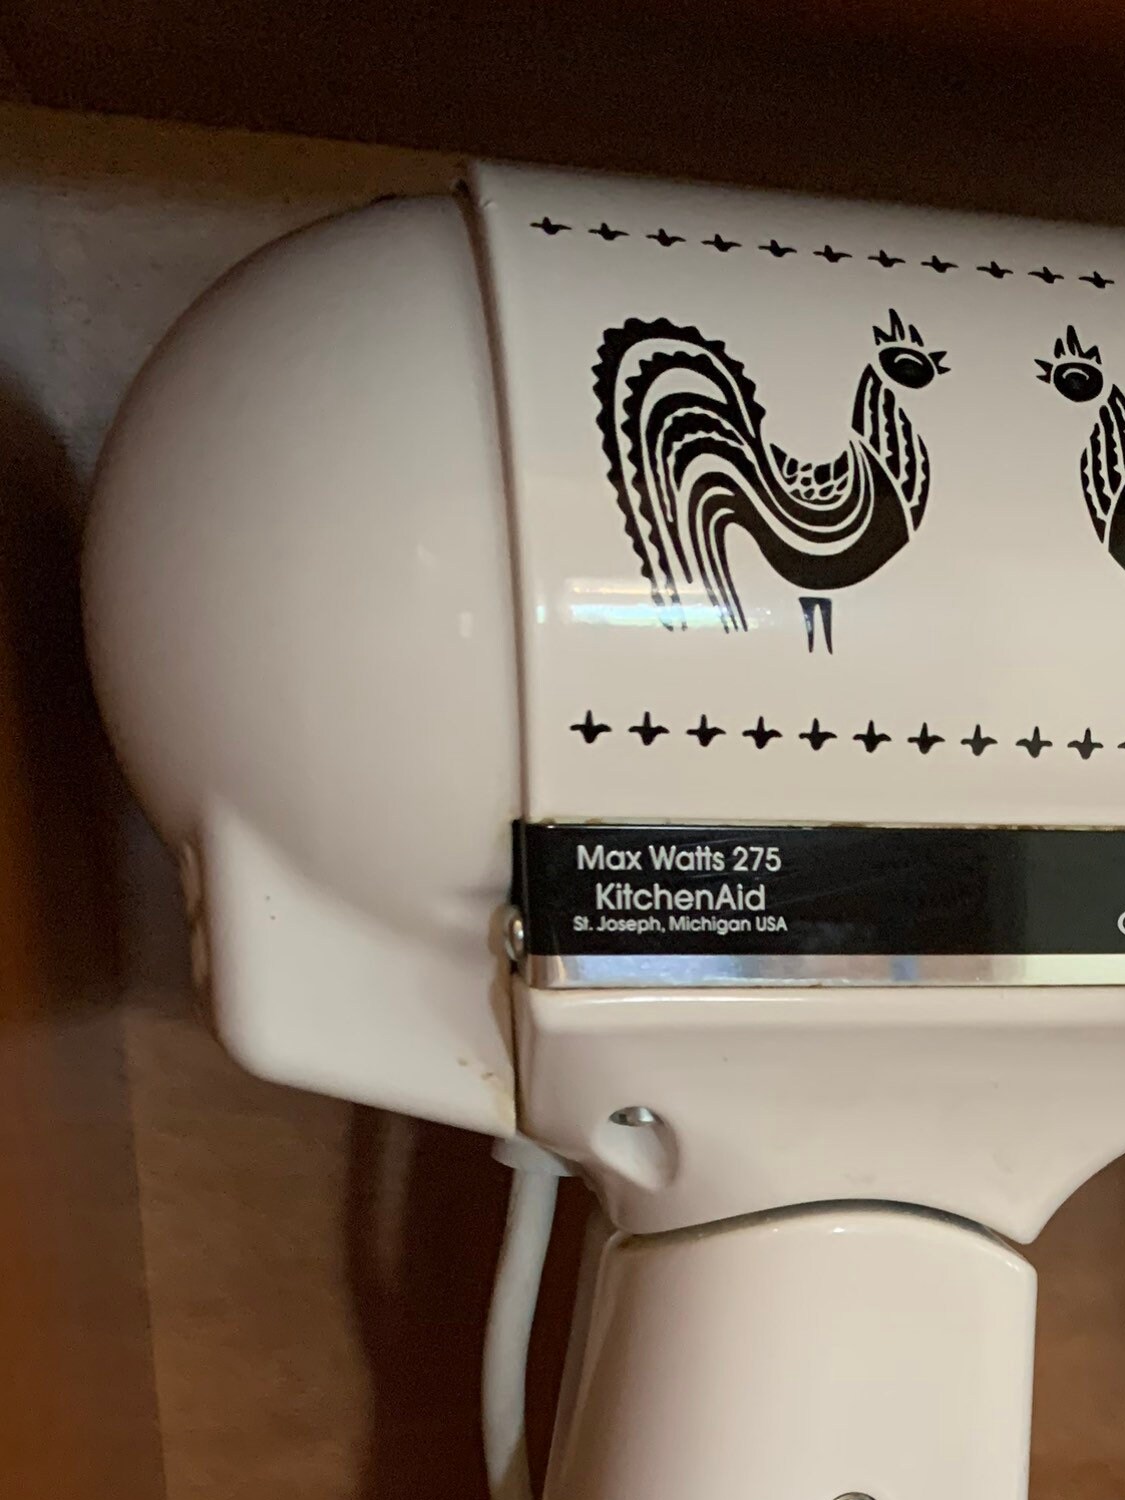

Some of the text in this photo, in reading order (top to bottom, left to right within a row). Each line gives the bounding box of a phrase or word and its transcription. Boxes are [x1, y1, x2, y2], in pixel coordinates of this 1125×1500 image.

[577, 844, 783, 872] Max Watts 275
[595, 882, 766, 911] KitchenAid
[573, 915, 788, 936] St. Joseph, Michigan USA
